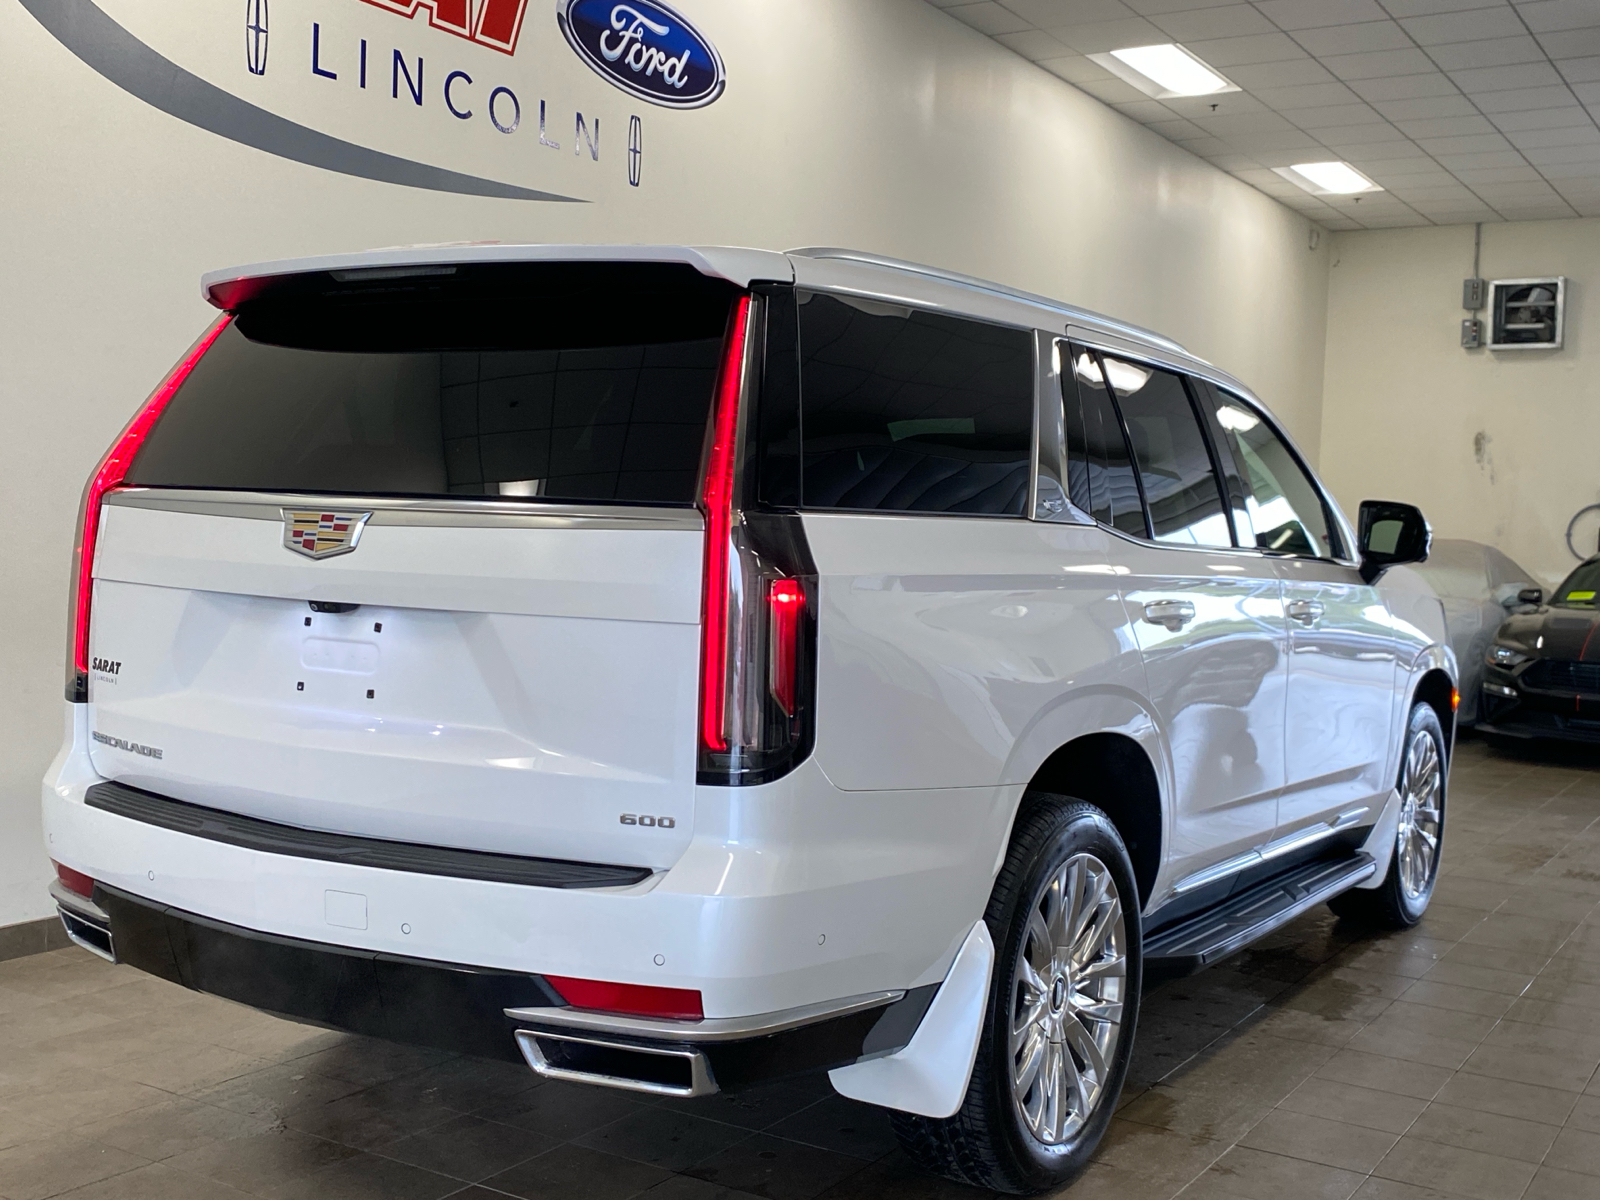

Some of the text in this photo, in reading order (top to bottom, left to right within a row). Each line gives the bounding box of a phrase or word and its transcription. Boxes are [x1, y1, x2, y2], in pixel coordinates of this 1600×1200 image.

[600, 4, 691, 89] Ford
[312, 22, 599, 162] LINCOLN
[92, 656, 122, 675] SARAT
[92, 730, 163, 760] ESCALADE
[620, 813, 676, 829] 600
